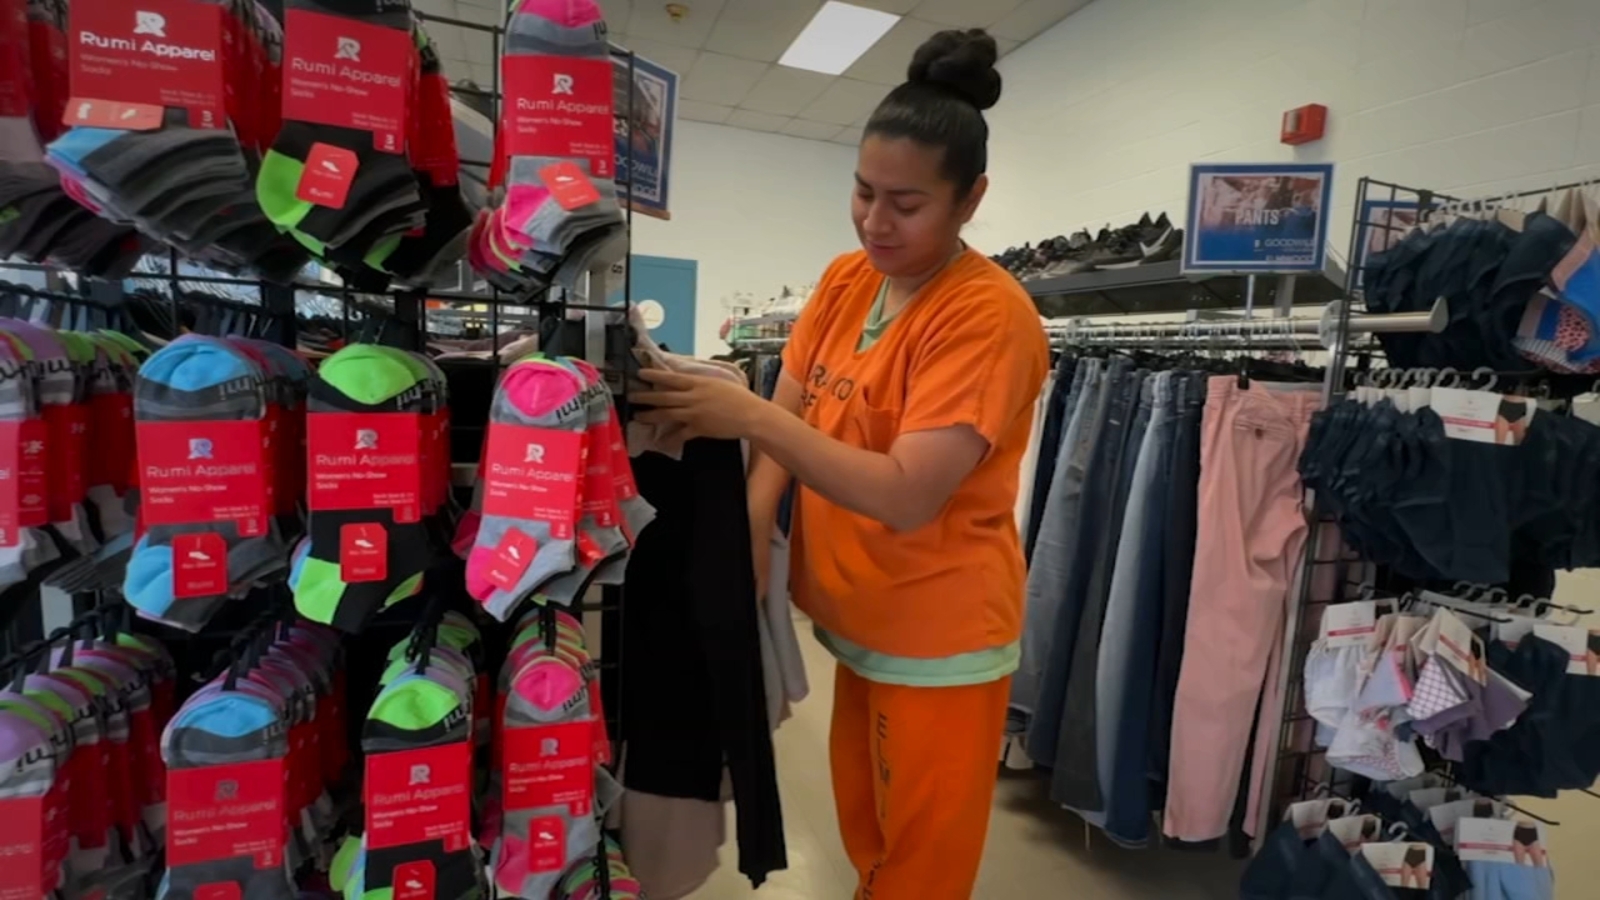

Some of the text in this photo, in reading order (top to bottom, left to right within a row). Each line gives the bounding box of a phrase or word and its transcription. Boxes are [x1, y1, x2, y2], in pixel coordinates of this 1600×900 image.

[80, 31, 216, 61] Rumi Apparel
[291, 57, 401, 87] Rumi Apparel
[517, 98, 609, 115] Rumi Apparel
[1235, 209, 1280, 225] PANTS
[316, 453, 415, 467] Rumi Apparel
[146, 462, 256, 478] Rumi Apparel
[490, 463, 574, 482] Rumi Apparel
[373, 790, 411, 806] Rumi
[174, 808, 216, 821] Rumi
